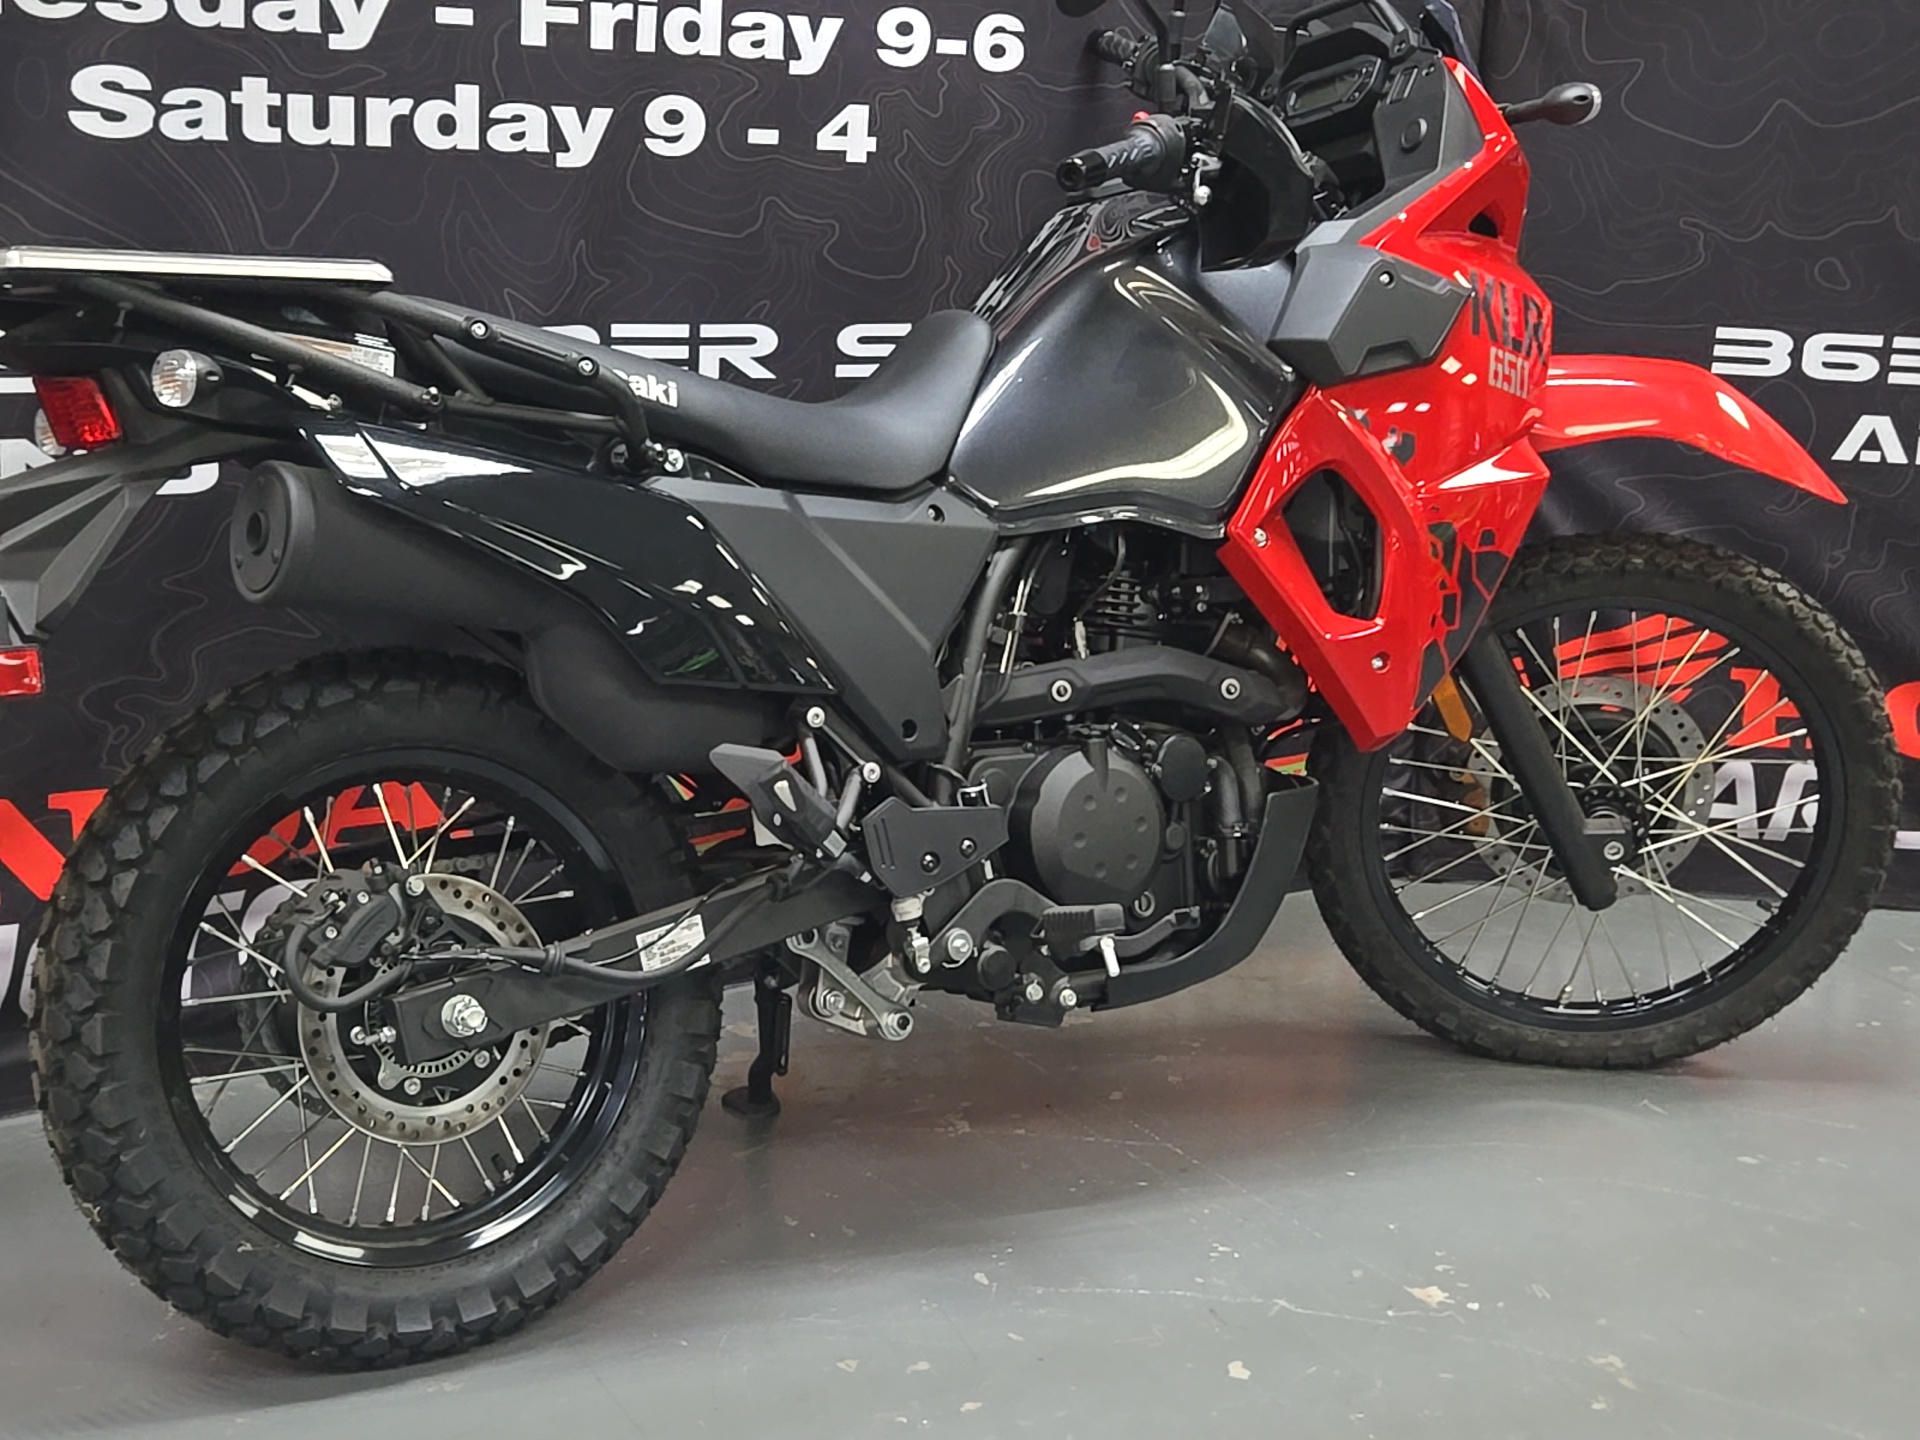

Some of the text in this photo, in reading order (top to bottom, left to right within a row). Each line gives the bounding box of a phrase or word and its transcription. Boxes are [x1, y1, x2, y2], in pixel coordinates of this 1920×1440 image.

[520, 0, 845, 75] Friday
[876, 7, 1026, 73] 9-6
[67, 64, 877, 168] Saturday 9 - 4
[541, 323, 779, 380] ER
[1470, 268, 1546, 366] KLR
[1488, 345, 1530, 400] 650
